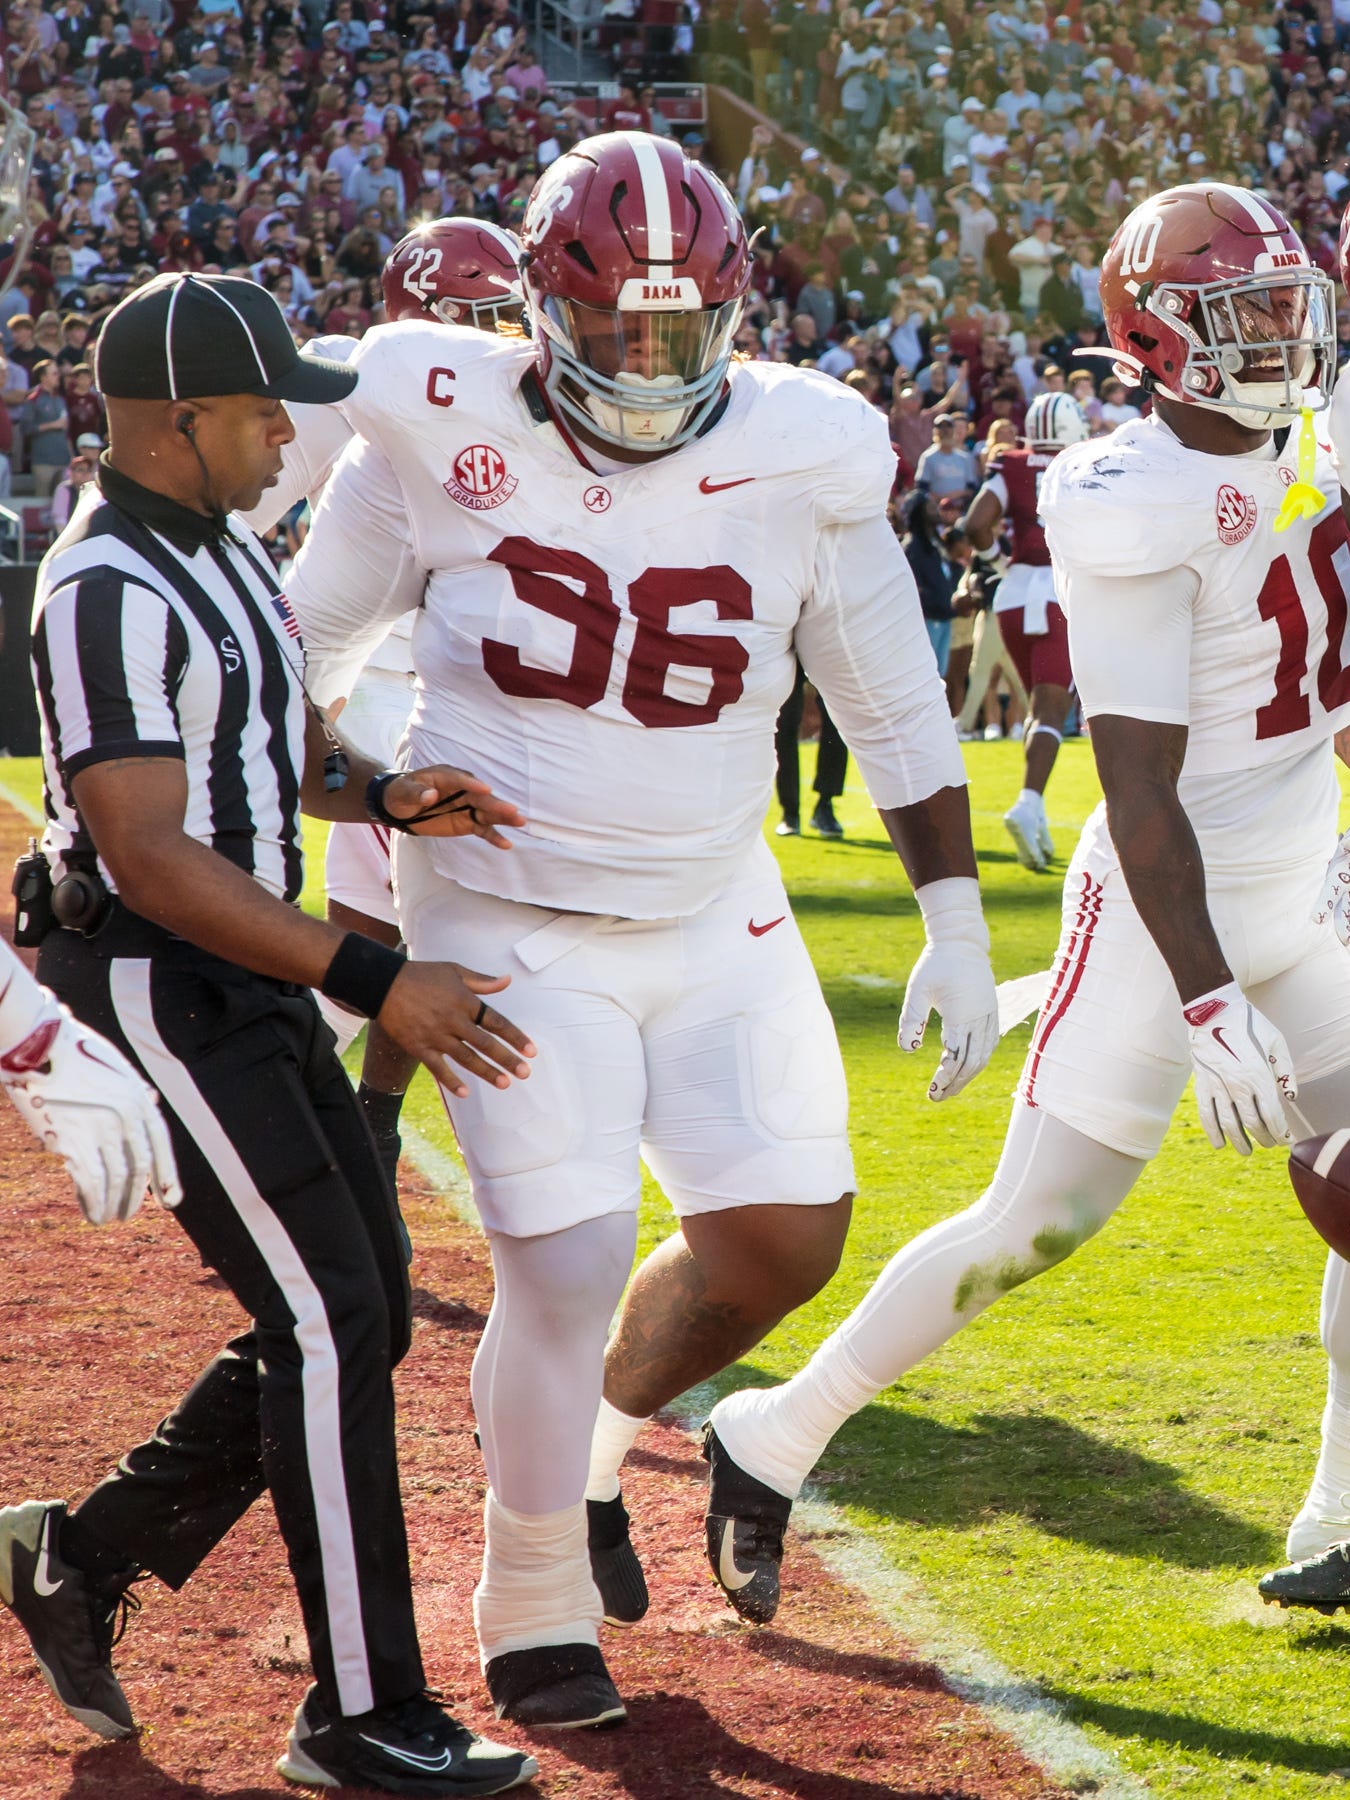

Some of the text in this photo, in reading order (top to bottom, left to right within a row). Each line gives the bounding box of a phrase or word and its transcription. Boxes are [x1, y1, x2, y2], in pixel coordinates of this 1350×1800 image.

[1119, 215, 1163, 277] 10
[1271, 252, 1302, 268] BAMA
[402, 247, 443, 290] 22
[642, 285, 682, 299] BAMA
[426, 366, 456, 407] C
[455, 446, 503, 493] SEC
[452, 488, 511, 509] GRADUATE
[587, 490, 605, 507] A
[1218, 486, 1246, 529] SEC
[1224, 508, 1256, 542] GRADUATE
[482, 536, 753, 728] 96
[220, 635, 241, 674] S
